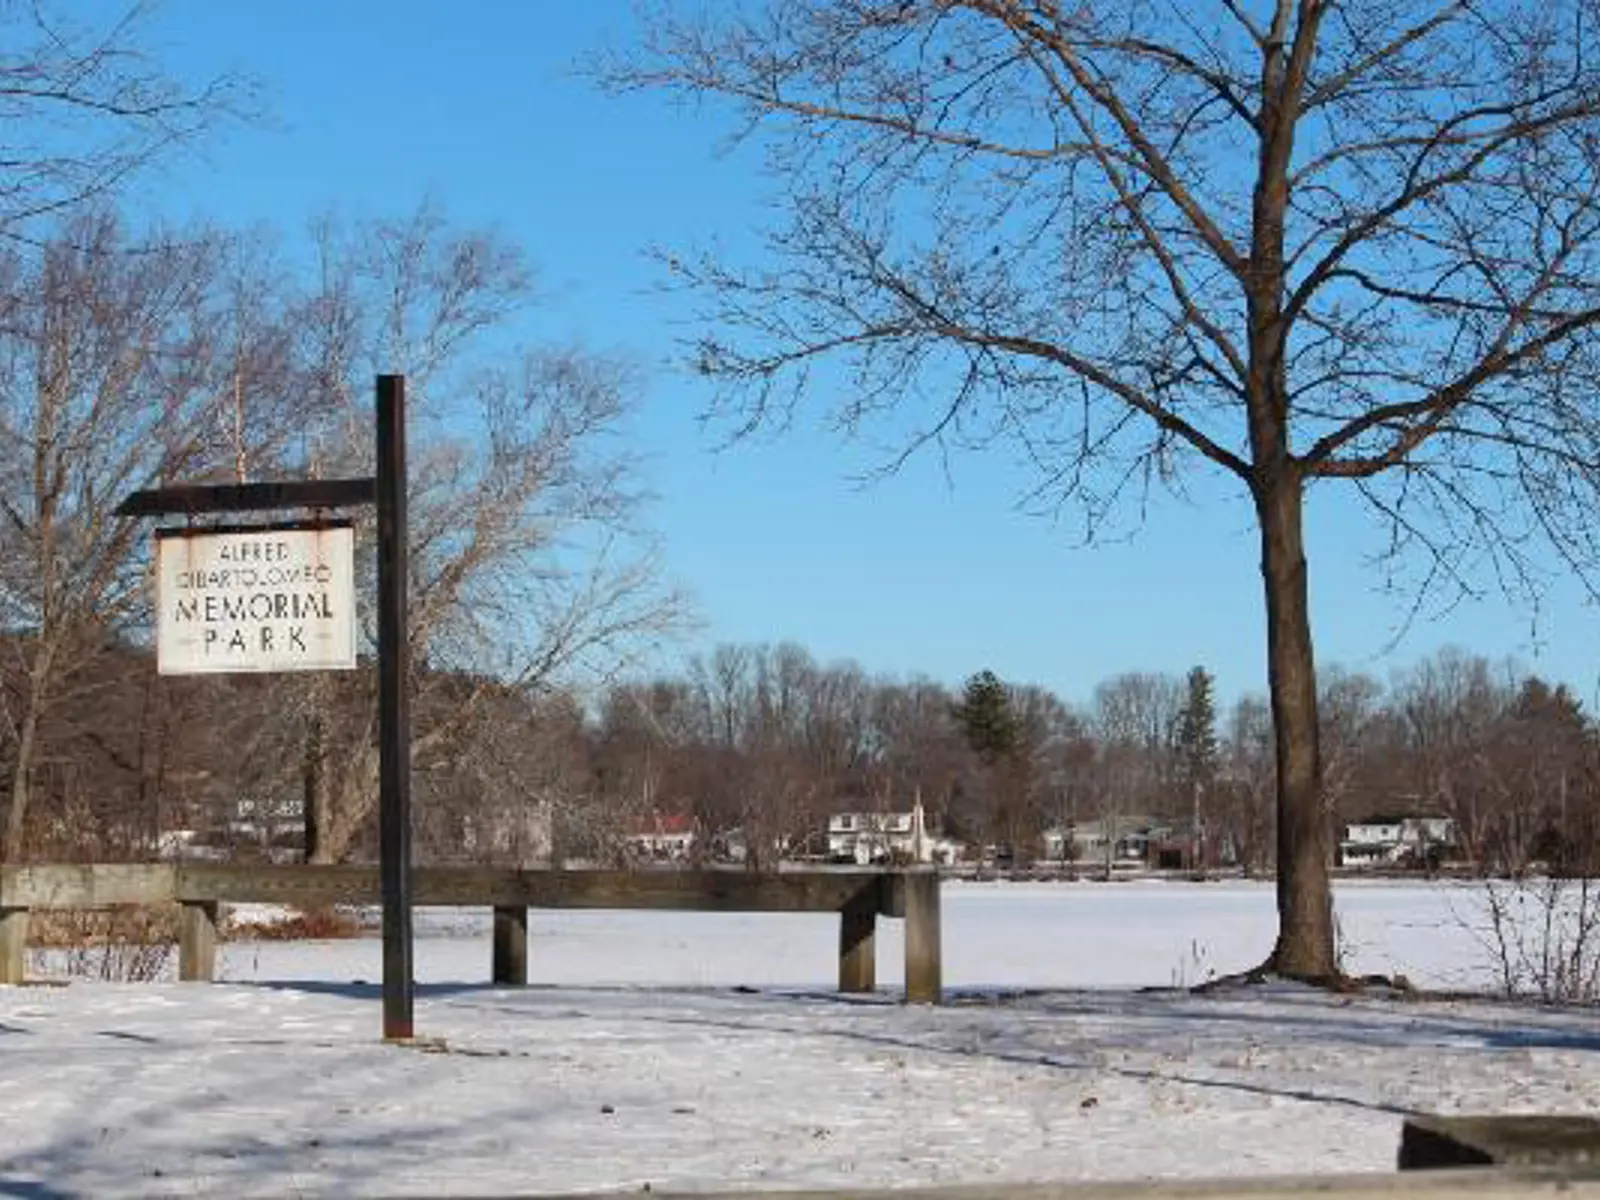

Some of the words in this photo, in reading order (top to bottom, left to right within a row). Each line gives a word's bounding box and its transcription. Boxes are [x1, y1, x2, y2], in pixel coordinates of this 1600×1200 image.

[220, 542, 288, 562] ALFRED
[175, 592, 333, 622] MEMORIAL
[204, 626, 306, 654] PARK
